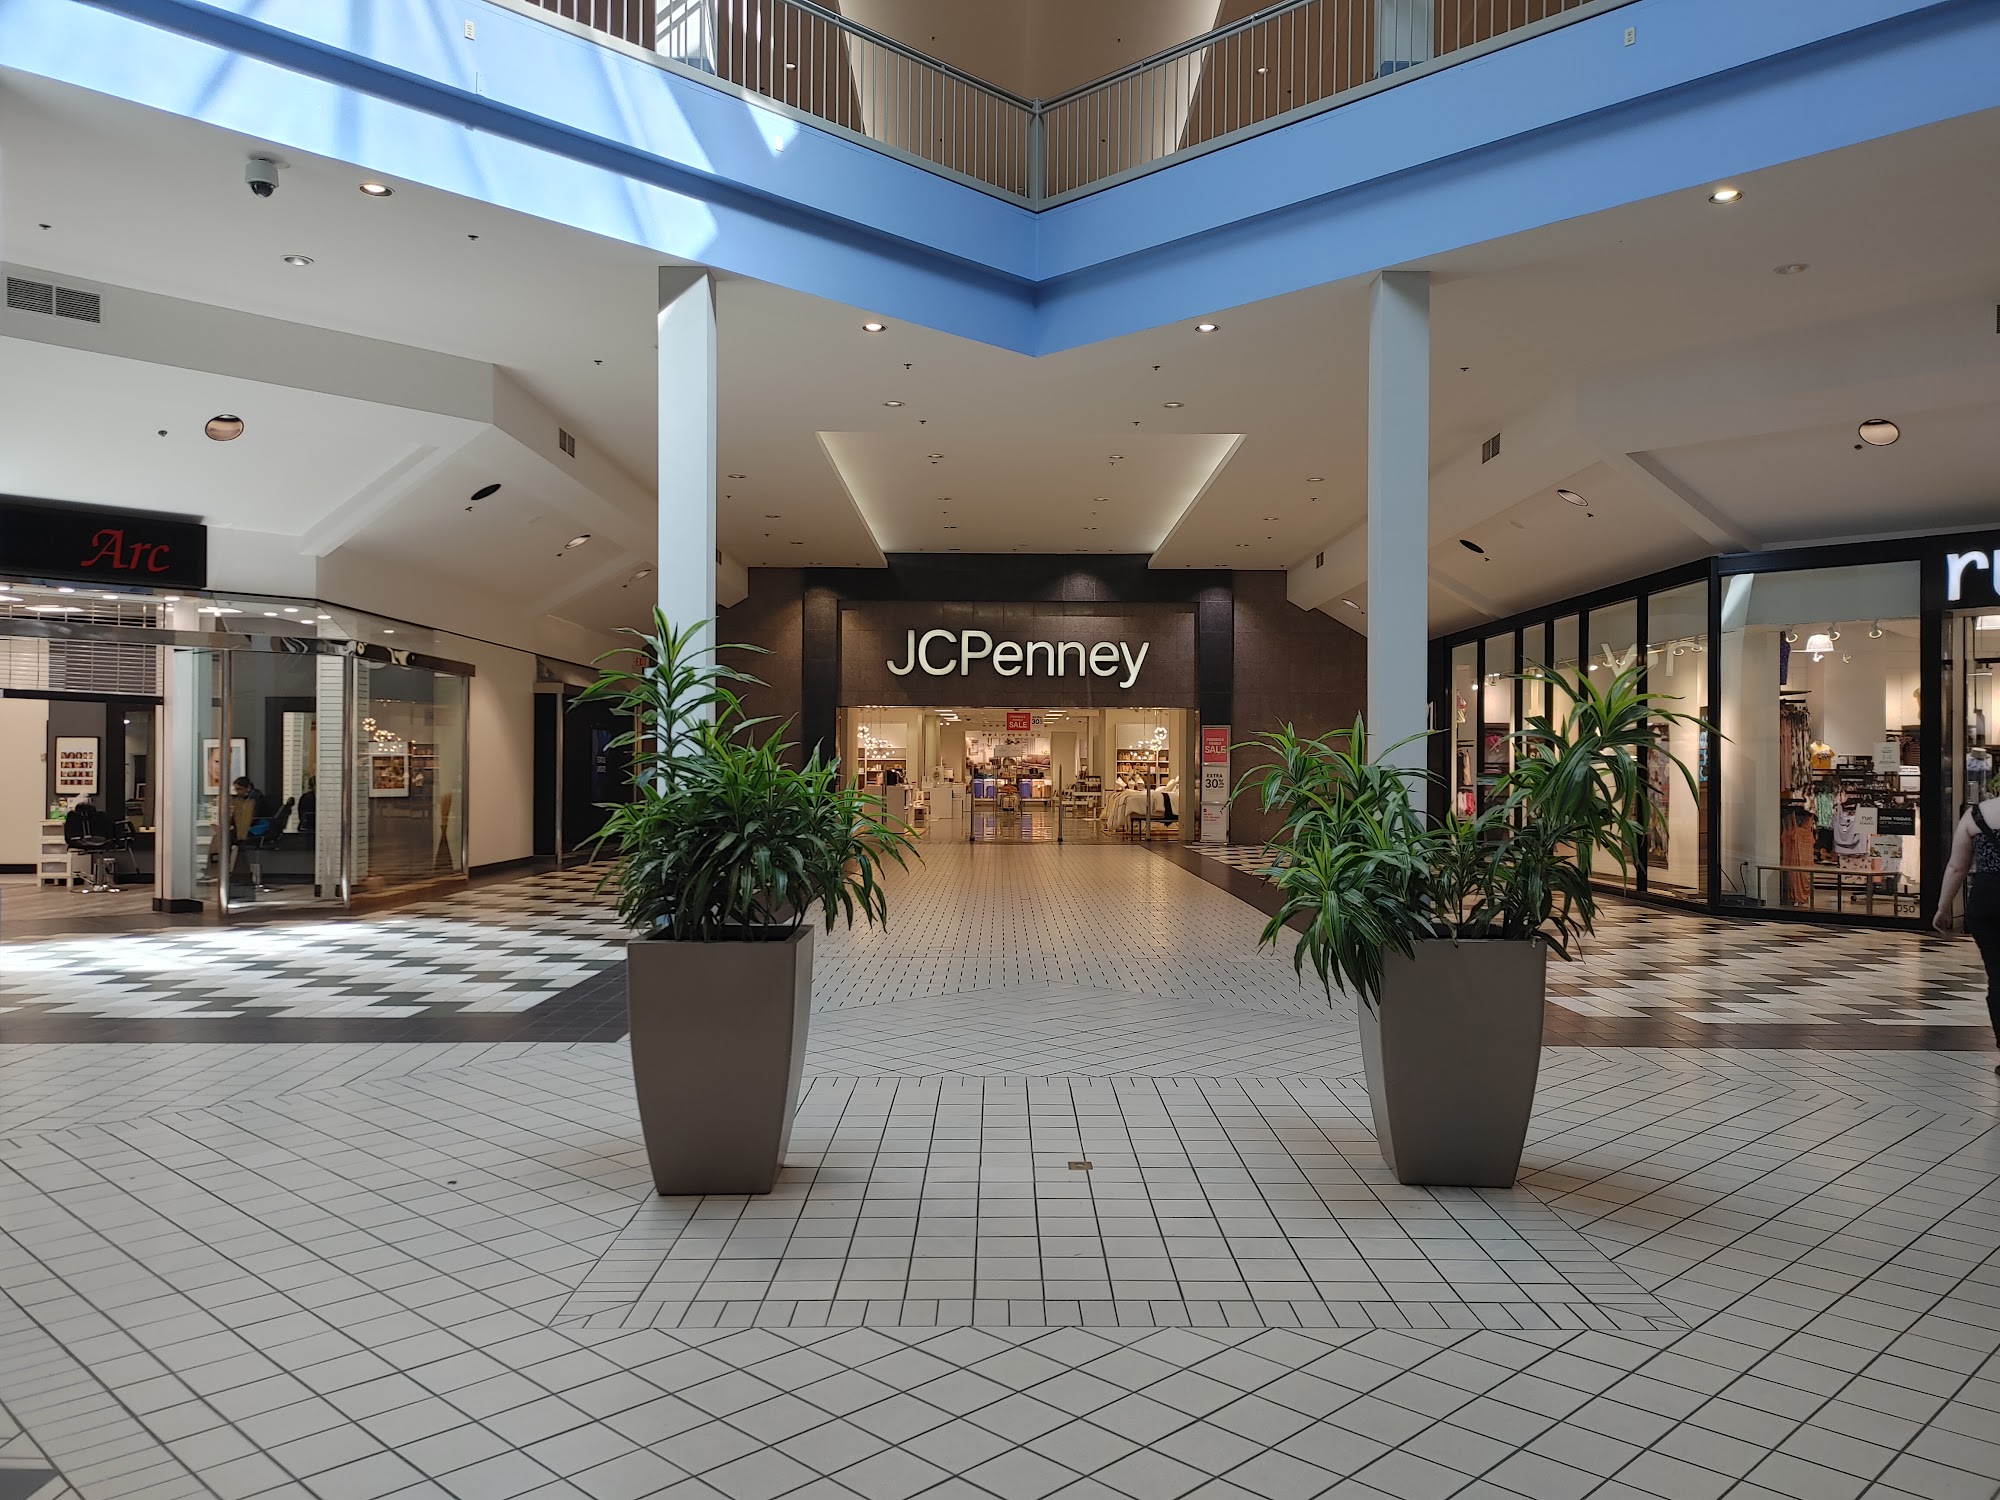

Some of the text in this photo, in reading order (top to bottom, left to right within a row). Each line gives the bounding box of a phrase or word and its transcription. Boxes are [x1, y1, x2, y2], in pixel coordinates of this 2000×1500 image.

[81, 529, 170, 572] Arc
[886, 629, 1150, 689] JCPenney
[1205, 745, 1226, 753] SALE
